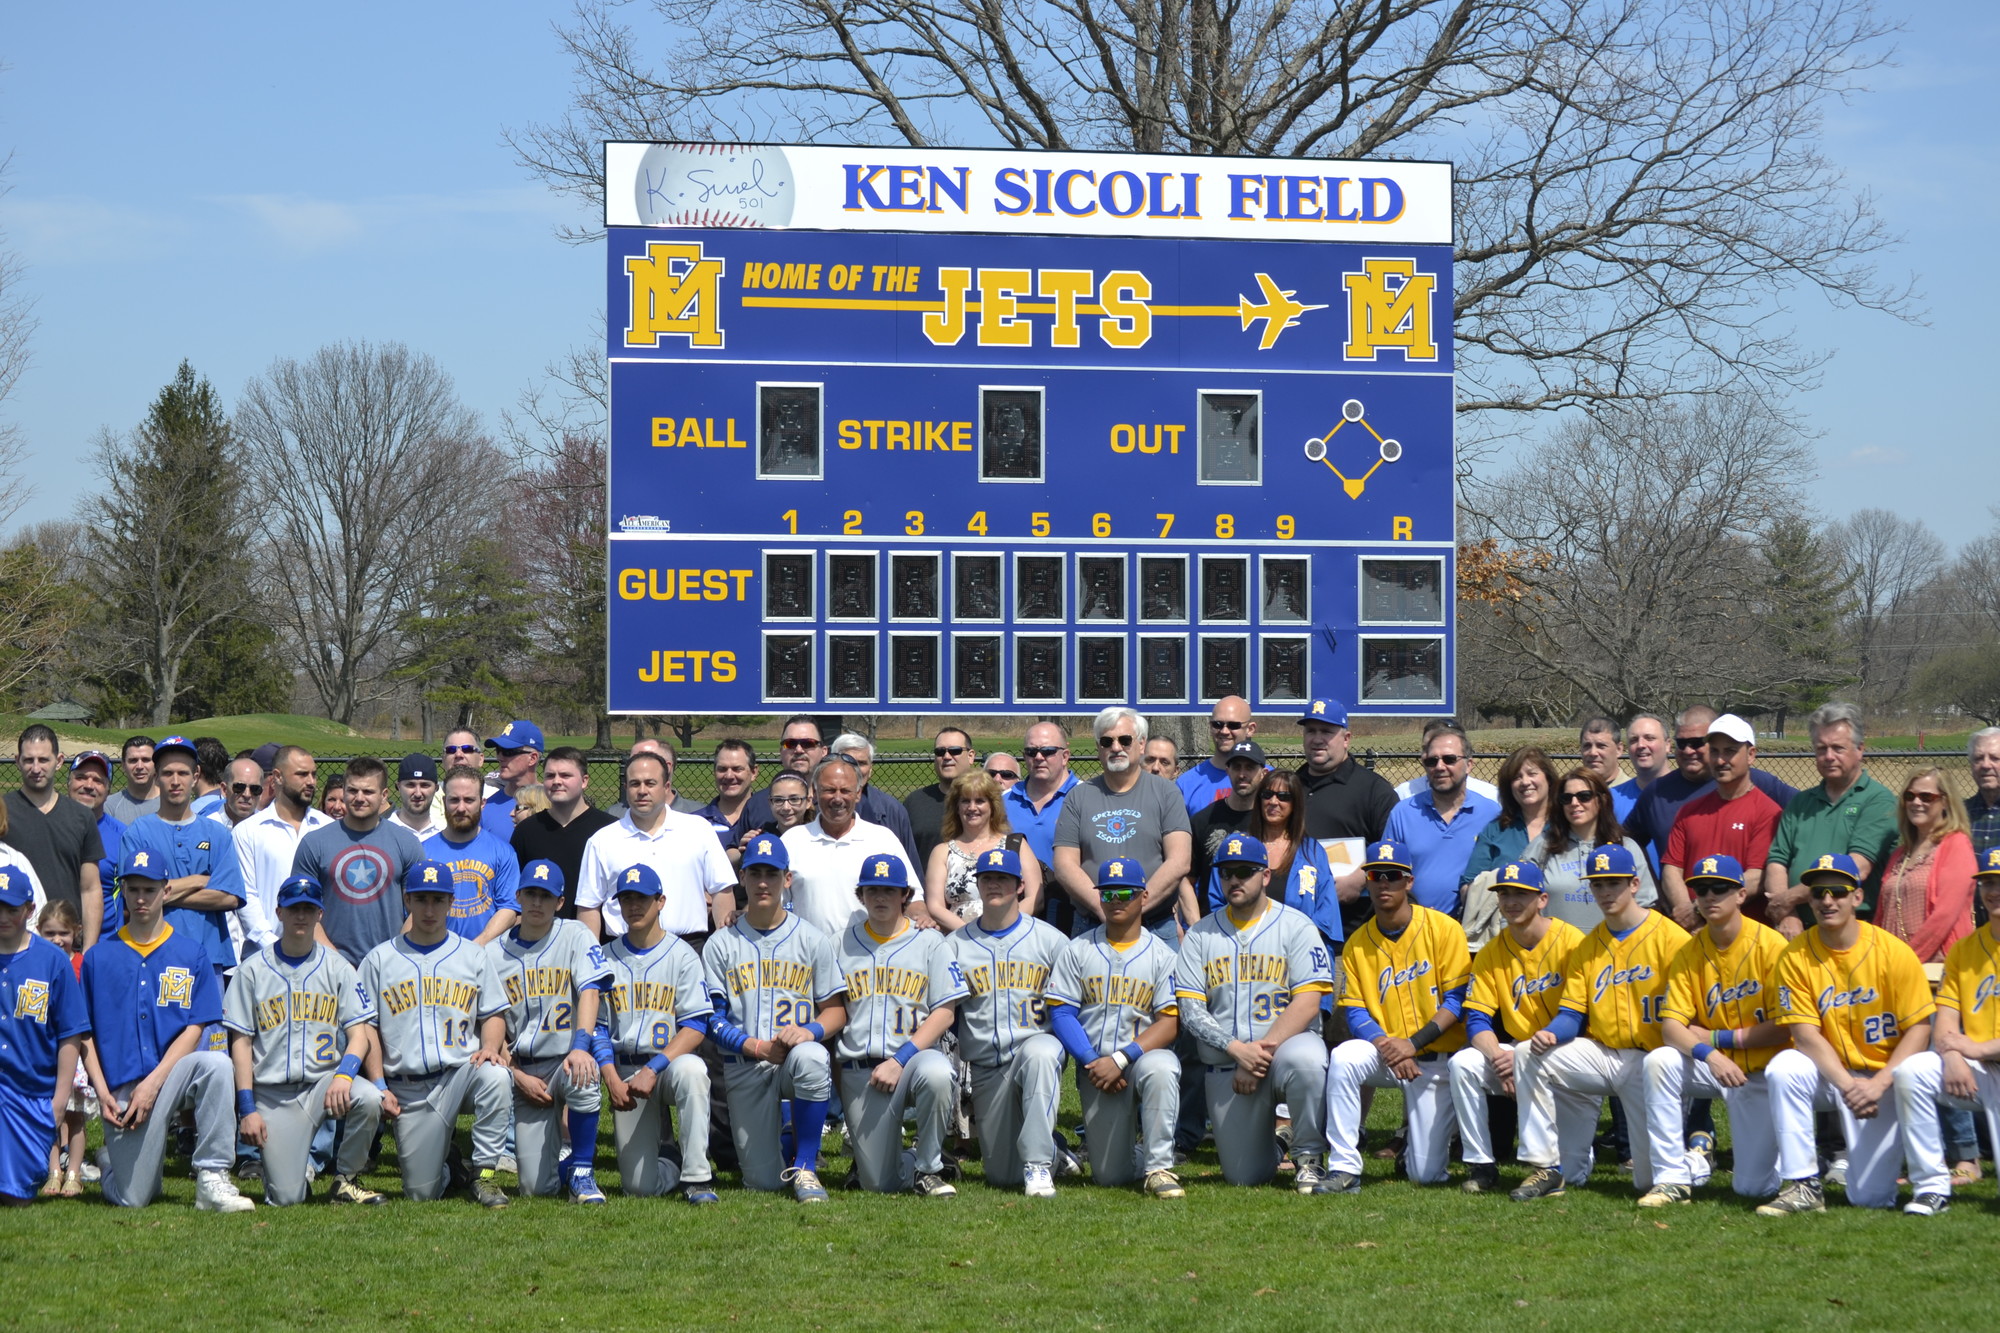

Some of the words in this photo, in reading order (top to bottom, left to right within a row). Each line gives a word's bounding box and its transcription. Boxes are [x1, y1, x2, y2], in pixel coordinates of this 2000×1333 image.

[738, 197, 764, 209] 501
[842, 163, 972, 214] KEN
[993, 167, 1202, 219] SICOLI
[1227, 173, 1406, 225] FIELD
[742, 262, 822, 291] HOME
[828, 264, 864, 291] OF
[872, 265, 921, 293] THE
[922, 266, 1152, 349] JETS
[651, 417, 747, 448] BALL
[838, 419, 973, 451] STRIKE
[1110, 424, 1186, 454] OUT
[781, 509, 798, 535] 1
[843, 510, 863, 535] 2
[905, 510, 925, 536] 3
[967, 511, 988, 536] 4
[1031, 512, 1051, 537] 5
[1092, 513, 1111, 538] 6
[1156, 513, 1175, 538] 7
[1215, 514, 1234, 538] 8
[1276, 514, 1295, 539] 9
[1393, 516, 1413, 540] R
[618, 568, 753, 601] GUEST
[638, 650, 737, 683] JETS
[762, 959, 812, 995] MEADOW
[875, 966, 929, 1002] MEADOW
[1378, 960, 1432, 1004] Jets
[1512, 971, 1563, 1011] Jets
[1593, 964, 1654, 1003] Jets
[292, 992, 338, 1027] MEADO
[382, 978, 418, 1016] EAST
[774, 998, 813, 1028] 20
[1018, 997, 1046, 1028] 15
[1254, 990, 1291, 1022] 35
[1706, 979, 1763, 1019] Jets
[1818, 985, 1879, 1018] Jets
[443, 1017, 469, 1048] 13
[541, 1001, 573, 1032] 12
[894, 1005, 919, 1036] 11
[1864, 1012, 1899, 1044] 22
[315, 1031, 335, 1062] 2
[651, 1020, 671, 1050] 8
